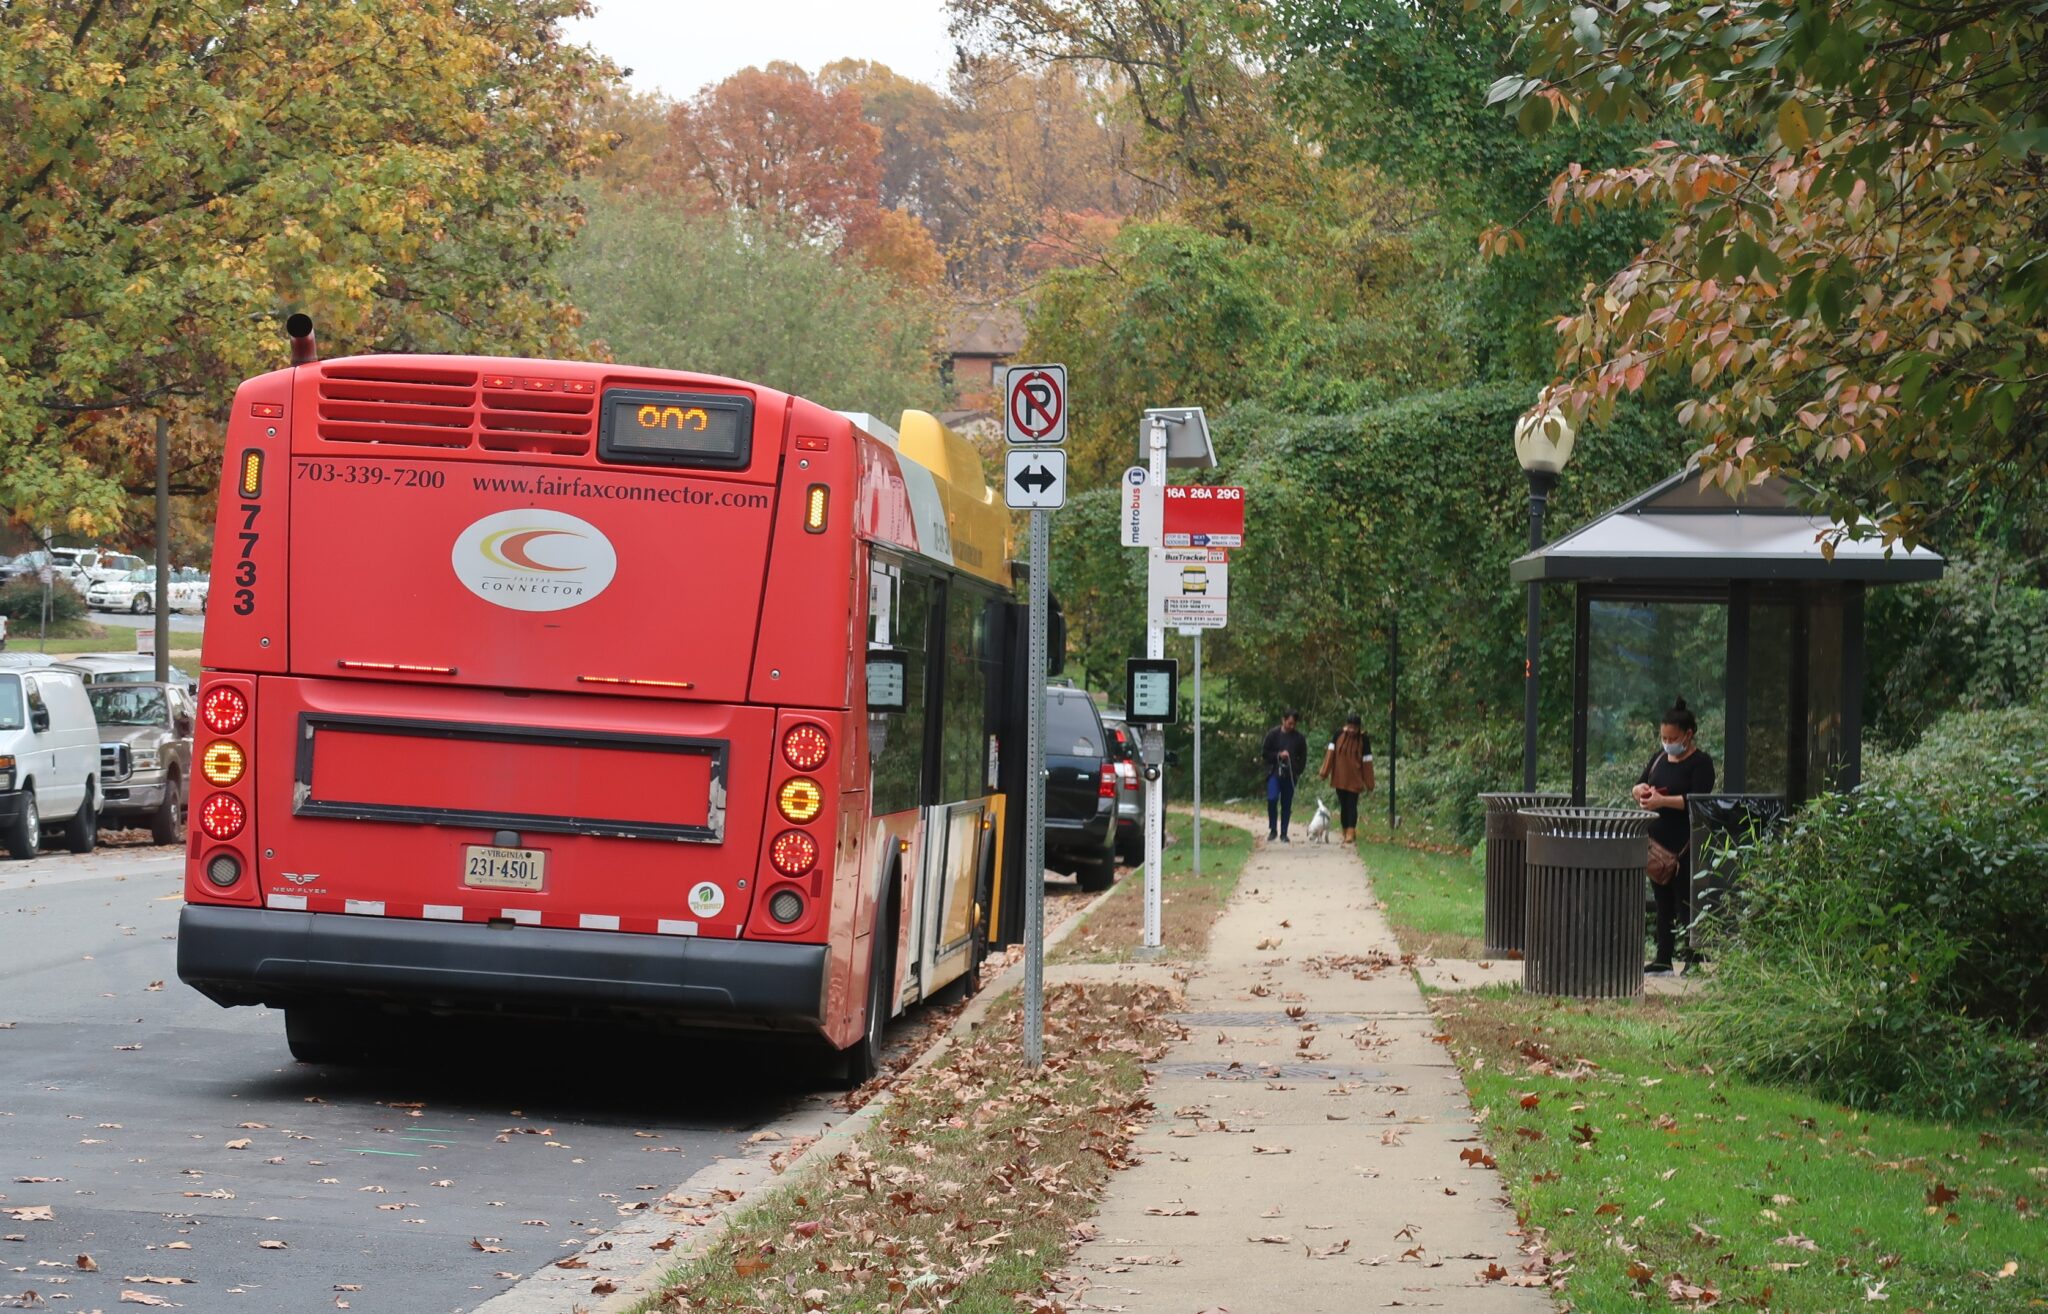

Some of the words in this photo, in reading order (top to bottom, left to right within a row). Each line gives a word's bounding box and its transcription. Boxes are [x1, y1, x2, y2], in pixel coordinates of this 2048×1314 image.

[296, 462, 445, 489] 703-339-7200
[472, 475, 769, 509] www.fairfaxconnector.com
[1166, 488, 1186, 498] 16A
[1190, 488, 1213, 499] 26A
[1216, 488, 1240, 499] 29G
[1130, 488, 1141, 544] metrobus
[233, 504, 262, 616] 7733
[481, 582, 584, 596] CONNECTOR
[487, 850, 524, 859] VIRGINIA
